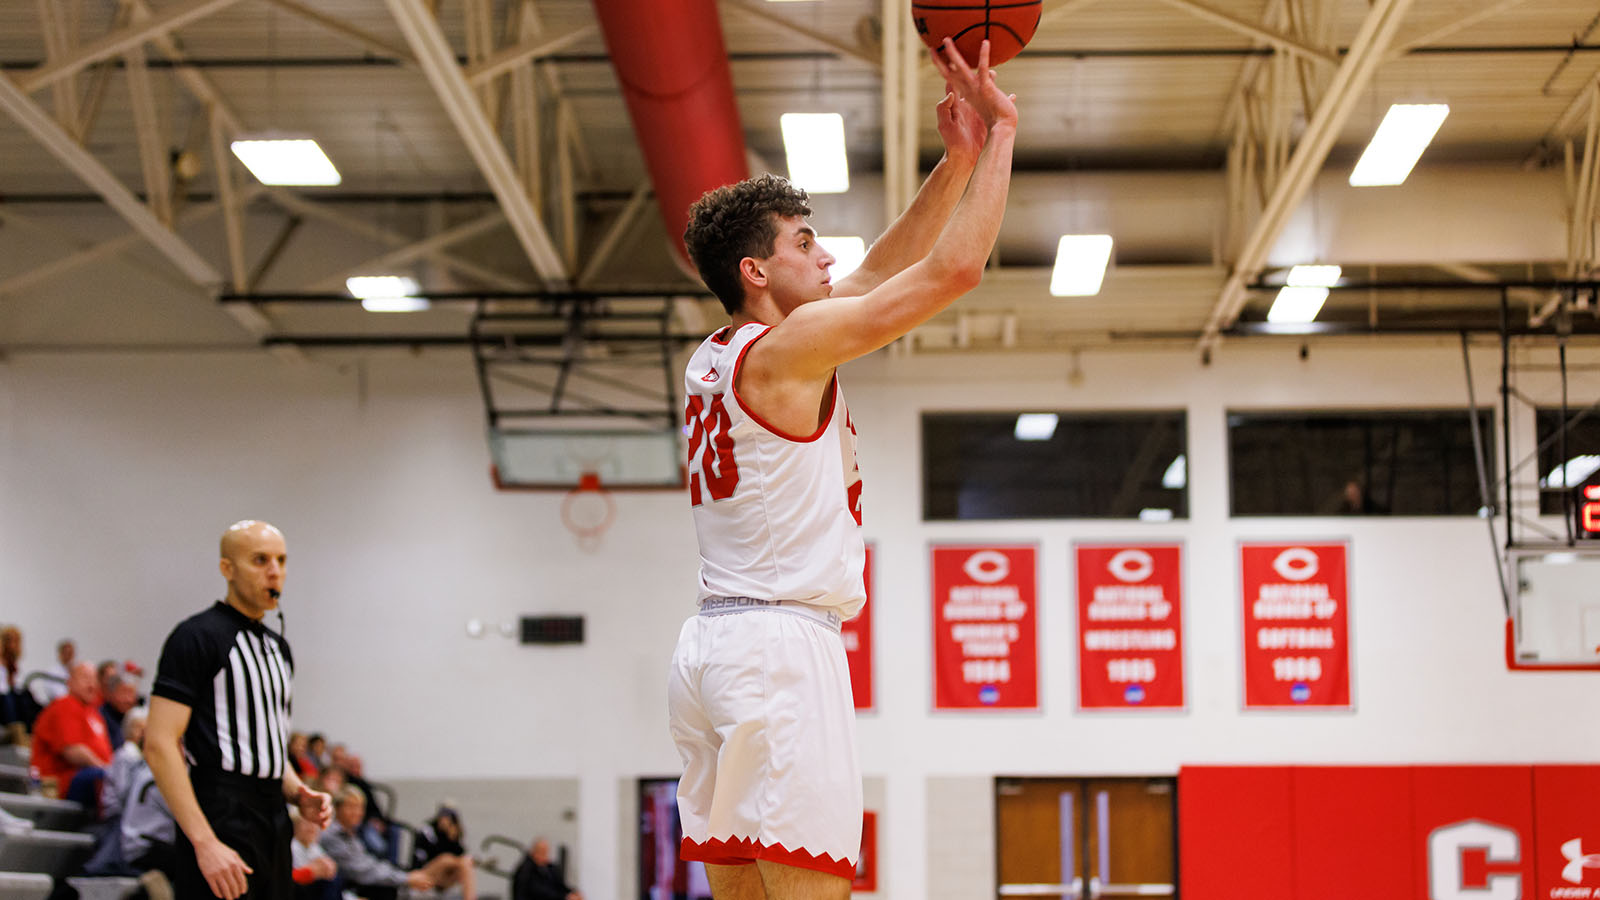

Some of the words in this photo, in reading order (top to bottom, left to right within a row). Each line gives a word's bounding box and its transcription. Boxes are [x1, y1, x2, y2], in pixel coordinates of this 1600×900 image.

[685, 393, 740, 508] 20
[964, 550, 1009, 583] C
[1108, 549, 1153, 582] C
[1273, 547, 1319, 581] C
[1094, 585, 1164, 602] NATIONAL
[1259, 584, 1329, 601] NATIONAL
[1084, 629, 1176, 650] WRESTLING
[1257, 627, 1334, 649] SOFTBALL
[1428, 819, 1522, 900] C
[1550, 887, 1592, 900] UNDER
